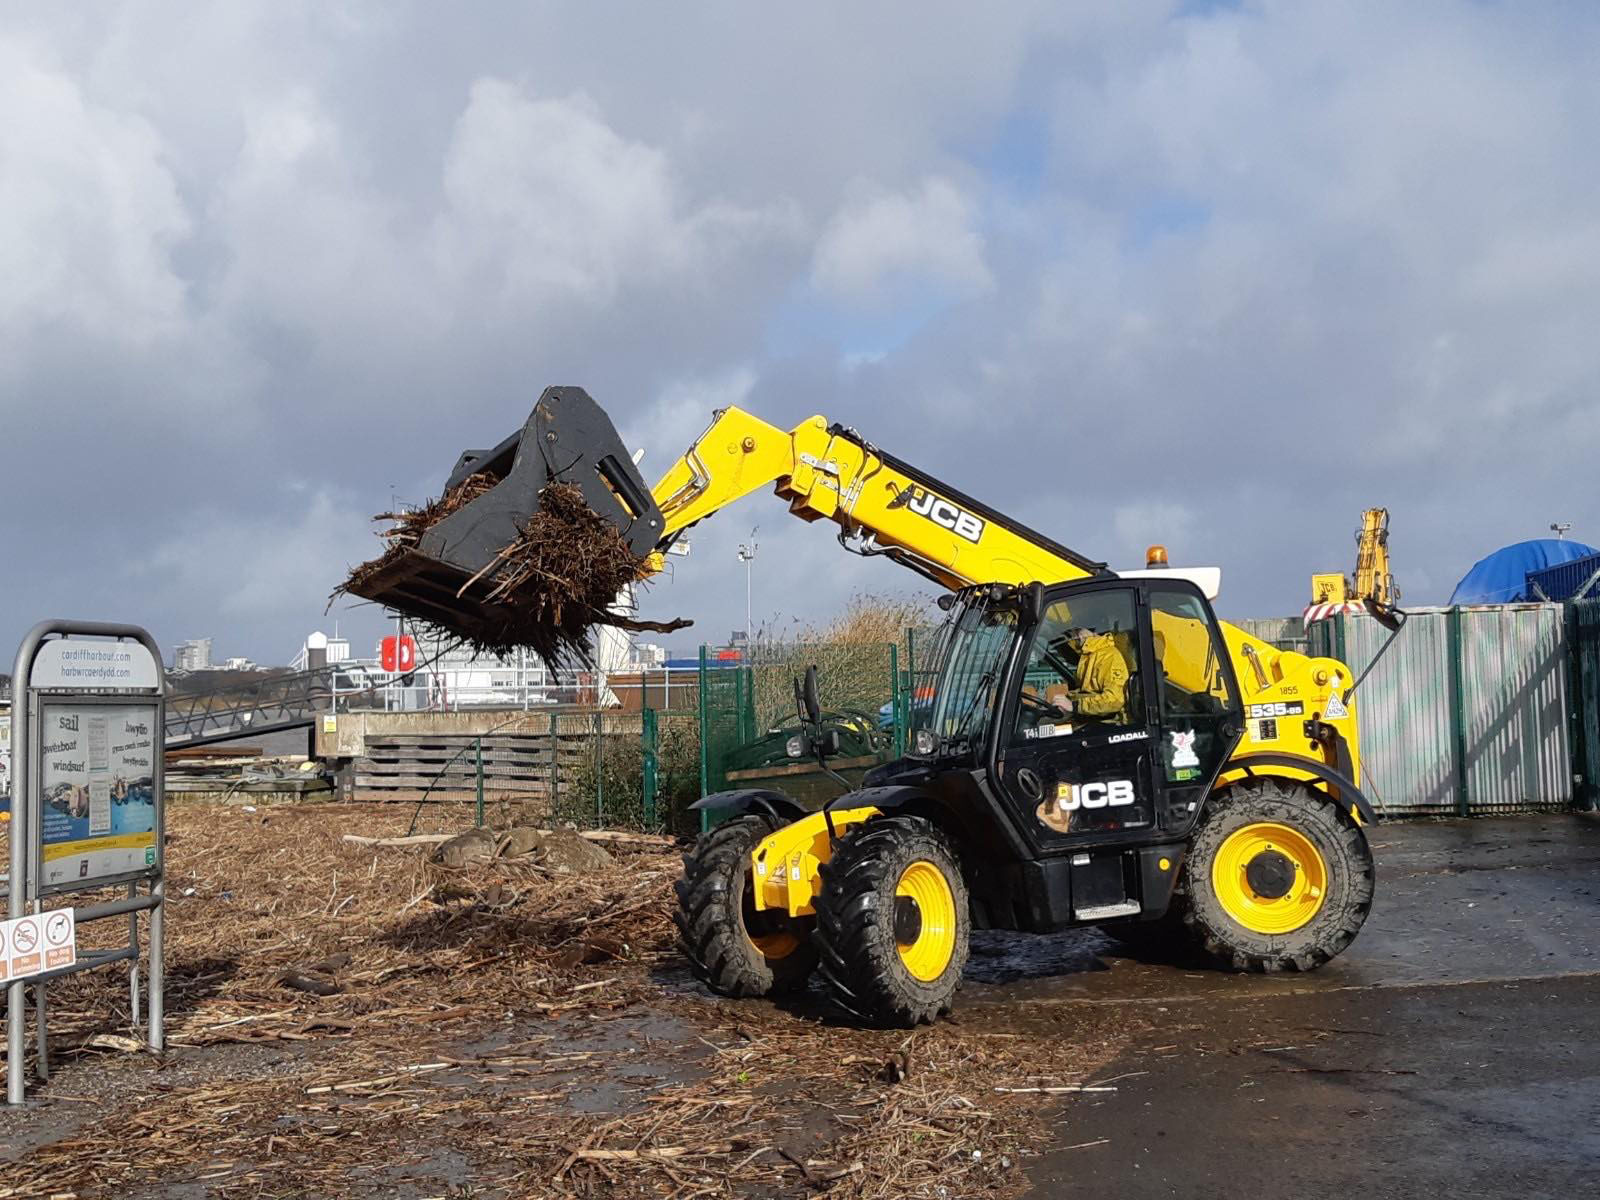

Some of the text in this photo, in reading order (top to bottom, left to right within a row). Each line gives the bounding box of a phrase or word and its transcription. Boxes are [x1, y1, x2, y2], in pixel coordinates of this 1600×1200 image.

[909, 493, 983, 542] JCB
[61, 649, 131, 662] cardiffharbour.com
[1280, 686, 1298, 696] 1855
[59, 715, 79, 732] sail
[1108, 731, 1149, 744] LOADALL
[53, 759, 85, 772] windsurf
[1058, 780, 1135, 811] JCB
